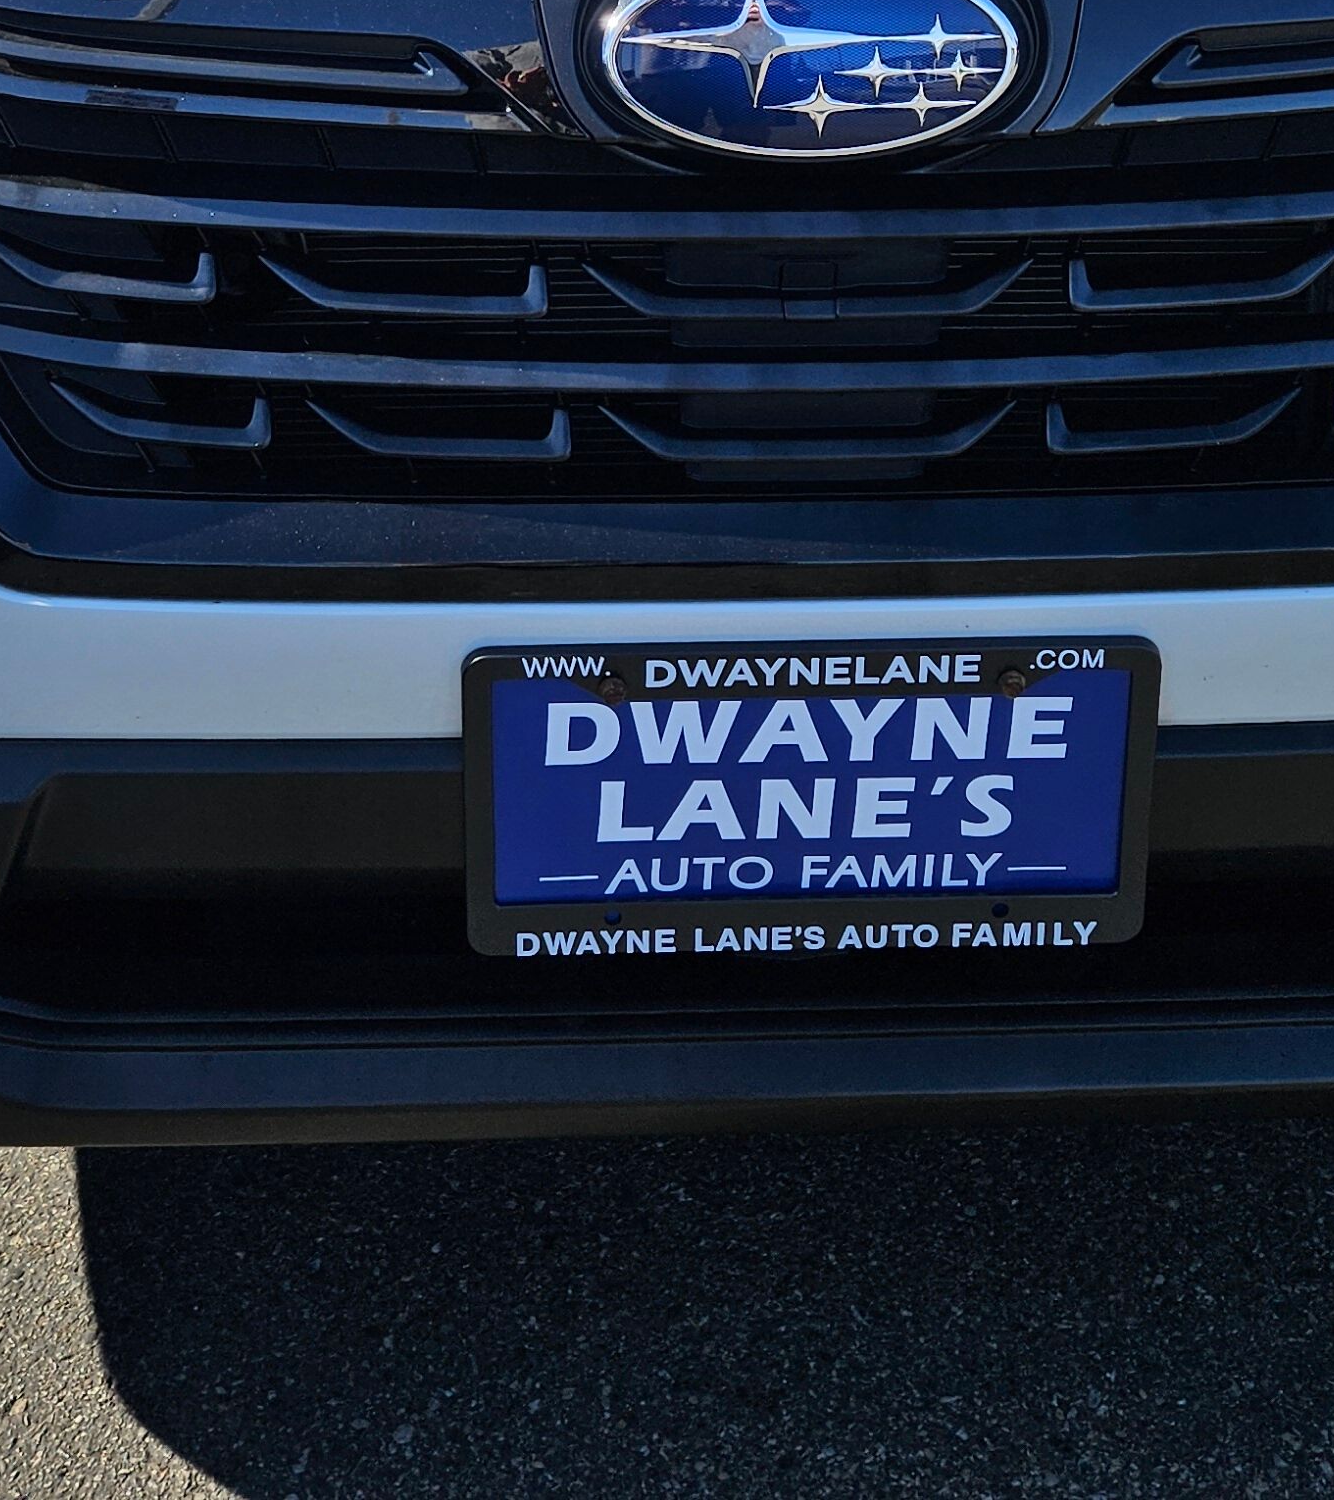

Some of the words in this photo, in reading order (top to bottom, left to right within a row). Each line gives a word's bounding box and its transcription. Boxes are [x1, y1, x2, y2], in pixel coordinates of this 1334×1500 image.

[521, 654, 612, 679] WWW.
[644, 653, 983, 689] DWAYNELANE
[1029, 647, 1106, 671] .COM
[543, 695, 1075, 767] DWAYNE
[595, 773, 1015, 844] LANE'S
[604, 855, 775, 895] AUTO
[801, 851, 1004, 890] FAMILY
[515, 928, 677, 958] DWAYNE
[693, 925, 826, 953] LANE'S
[837, 923, 940, 951] AUTO
[951, 920, 1099, 949] FAMILY
